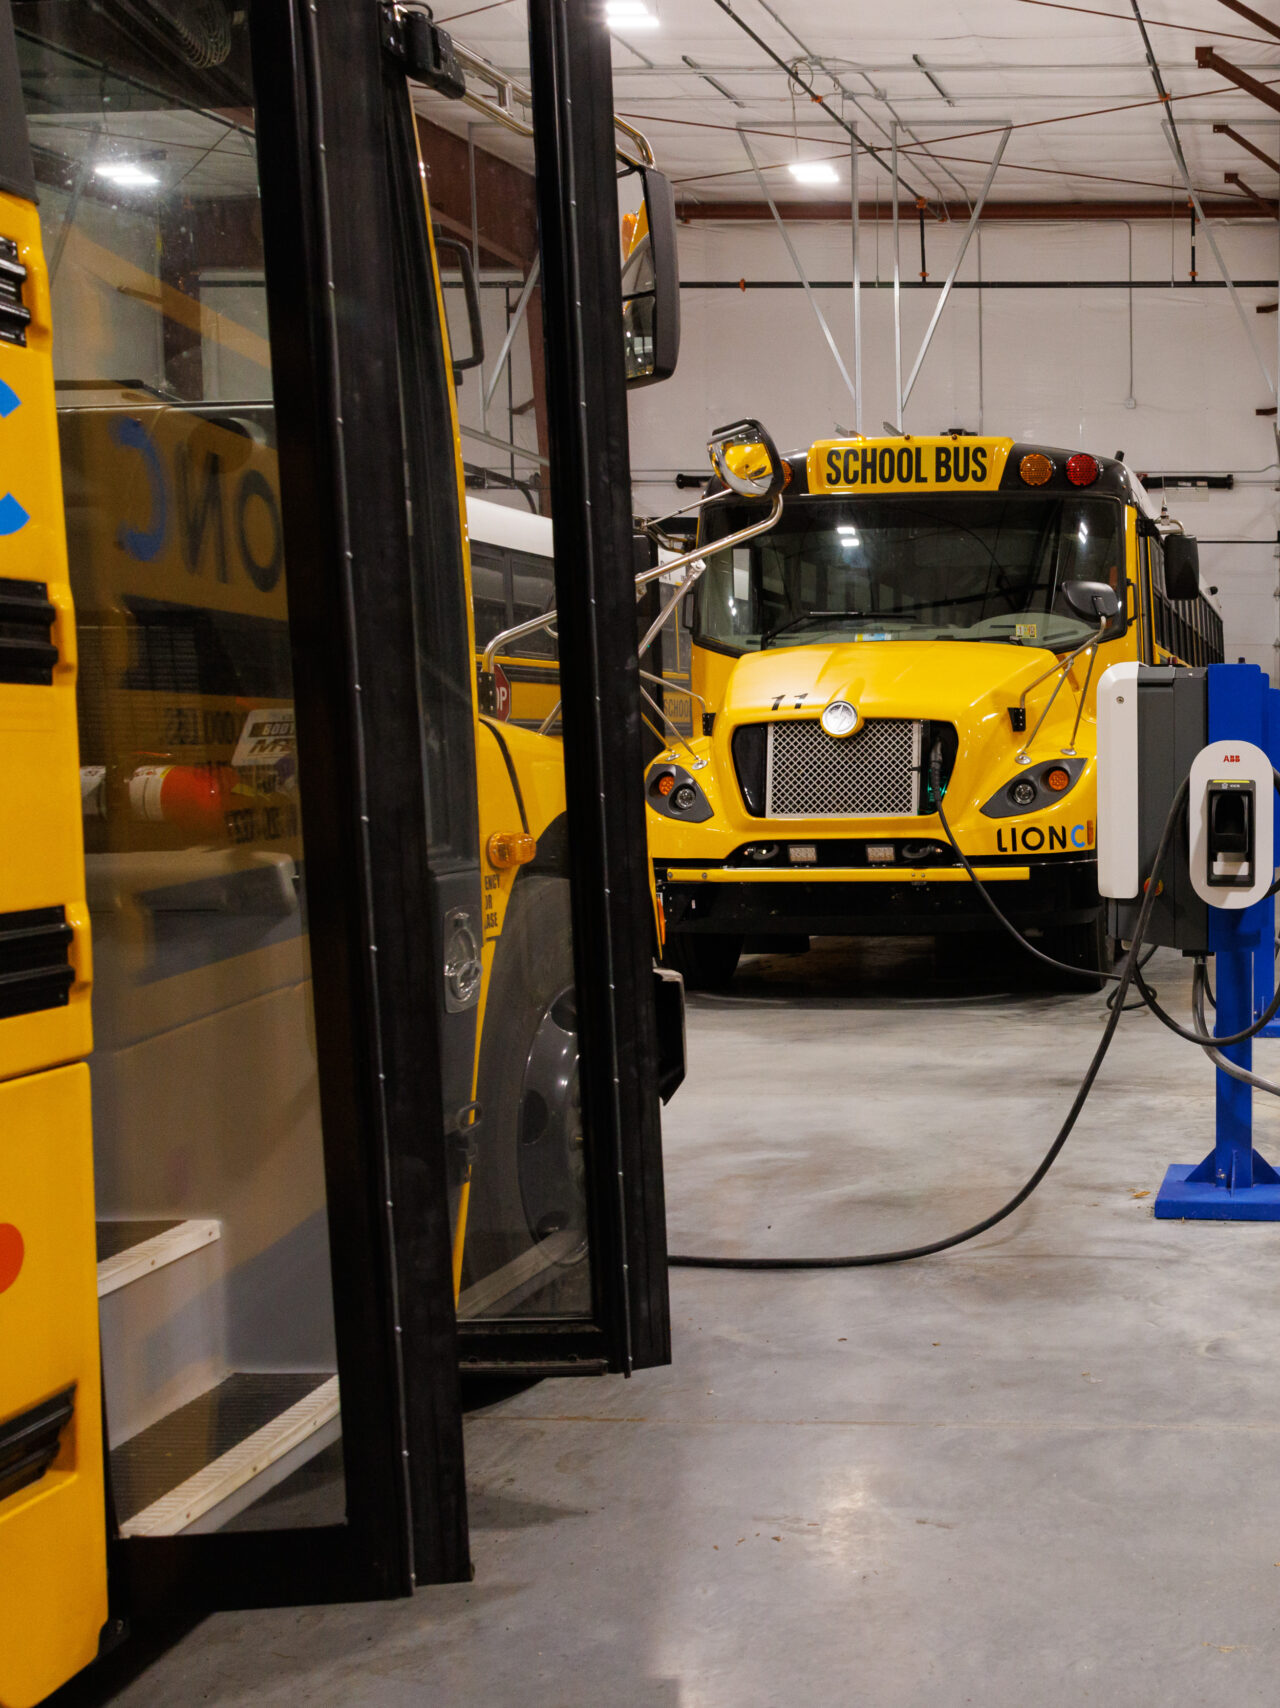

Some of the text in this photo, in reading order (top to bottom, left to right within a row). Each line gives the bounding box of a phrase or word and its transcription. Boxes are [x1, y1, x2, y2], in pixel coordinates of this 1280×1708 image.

[826, 446, 988, 485] SCHOOL BUS
[664, 698, 691, 718] SCHOO
[771, 692, 809, 711] 11
[1223, 754, 1241, 763] ABB
[997, 824, 1086, 853] LIONC
